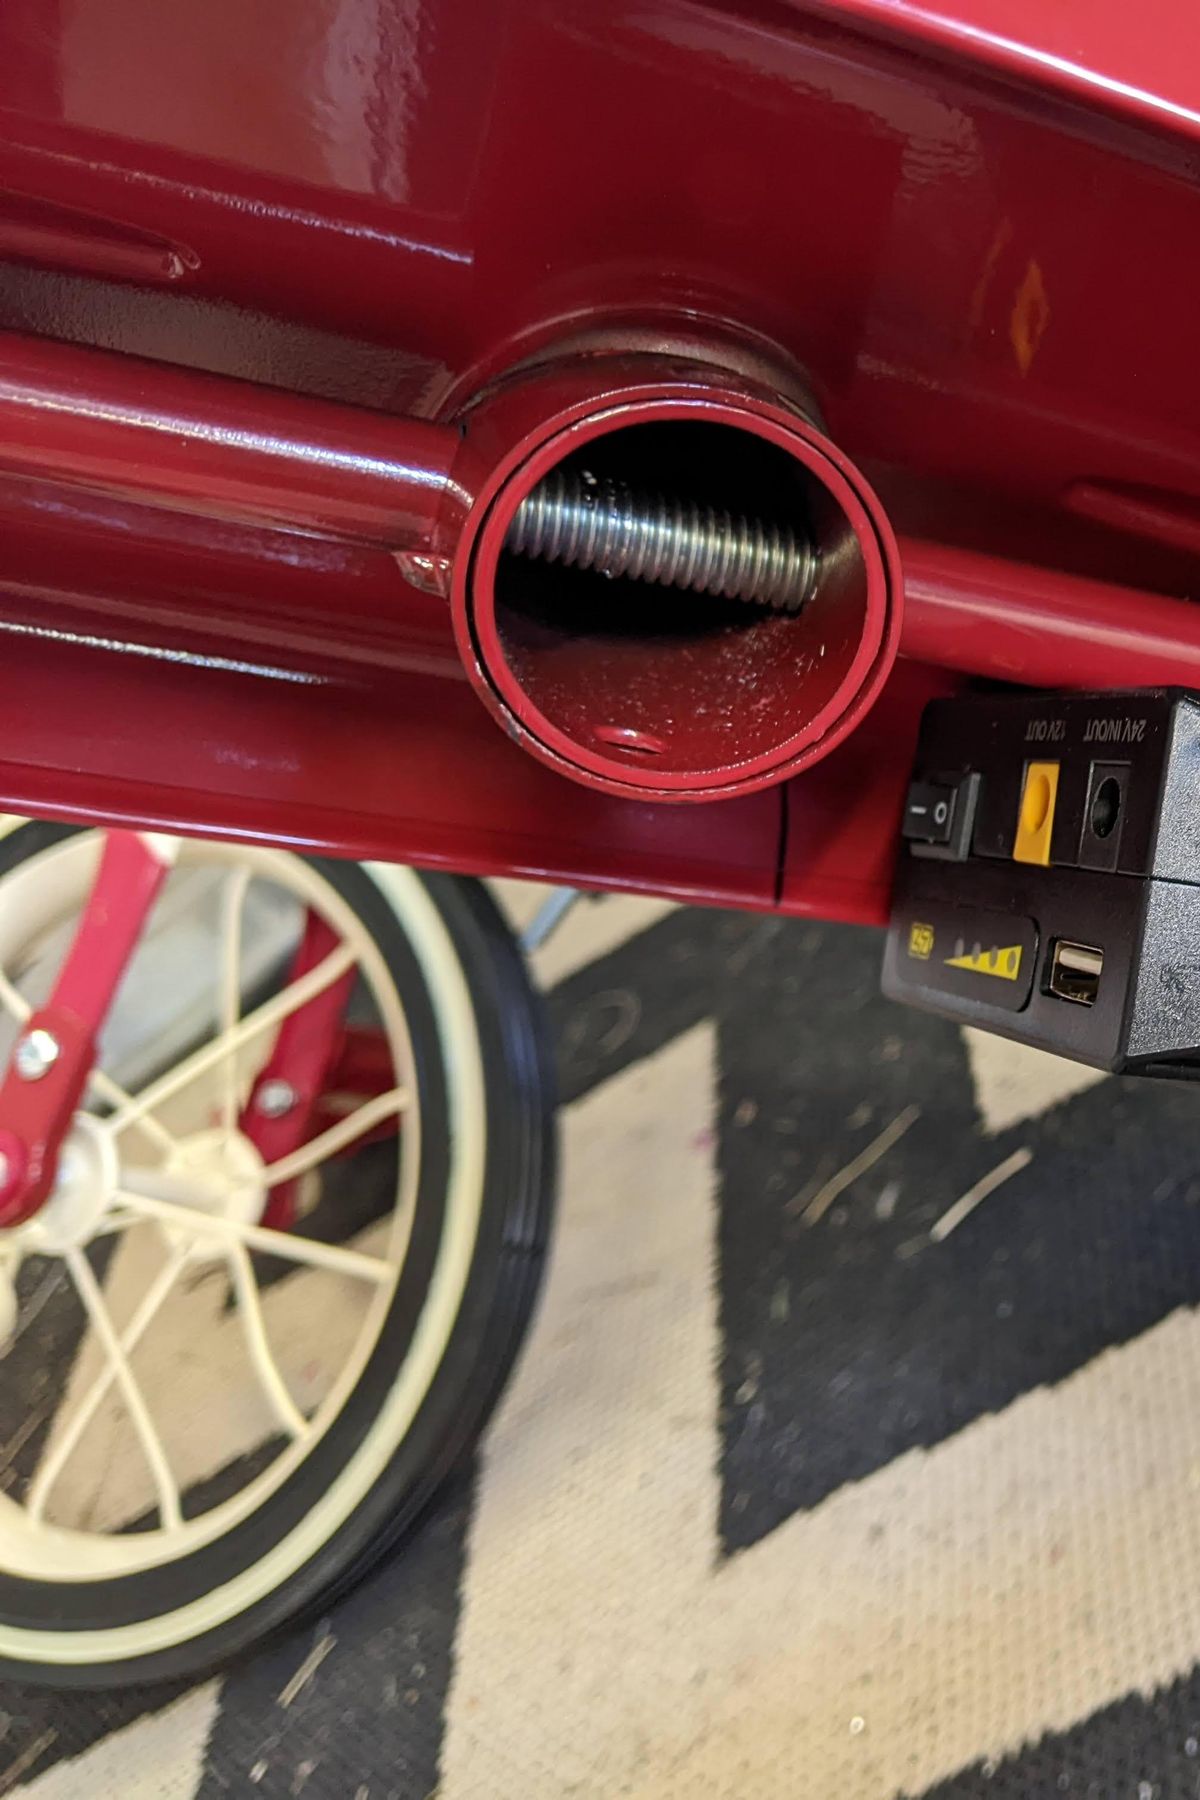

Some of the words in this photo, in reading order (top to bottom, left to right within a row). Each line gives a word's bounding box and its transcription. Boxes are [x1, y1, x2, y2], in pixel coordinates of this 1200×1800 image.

[1024, 719, 1048, 741] OUT
[1048, 719, 1066, 741] 12V
[1121, 719, 1147, 742] 24V
